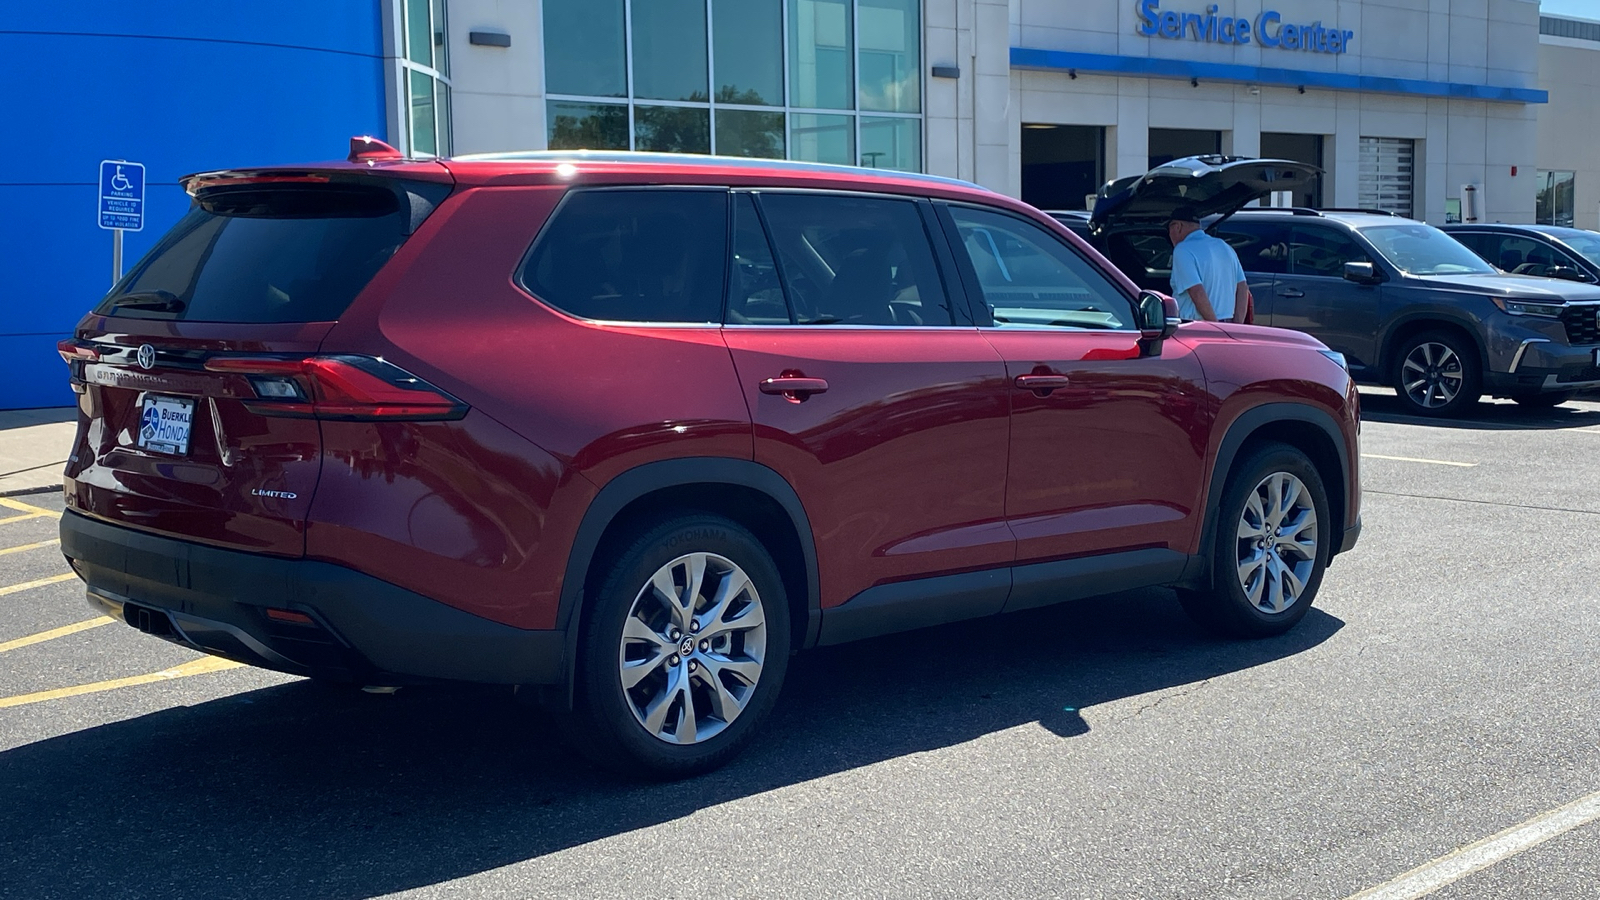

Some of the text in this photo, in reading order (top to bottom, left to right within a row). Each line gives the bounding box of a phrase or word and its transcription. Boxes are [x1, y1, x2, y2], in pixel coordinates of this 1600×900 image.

[1136, 0, 1354, 54] Service Center
[157, 420, 188, 442] HONDA
[251, 488, 297, 499] LIMITED
[662, 528, 727, 550] YOKOHAMA
